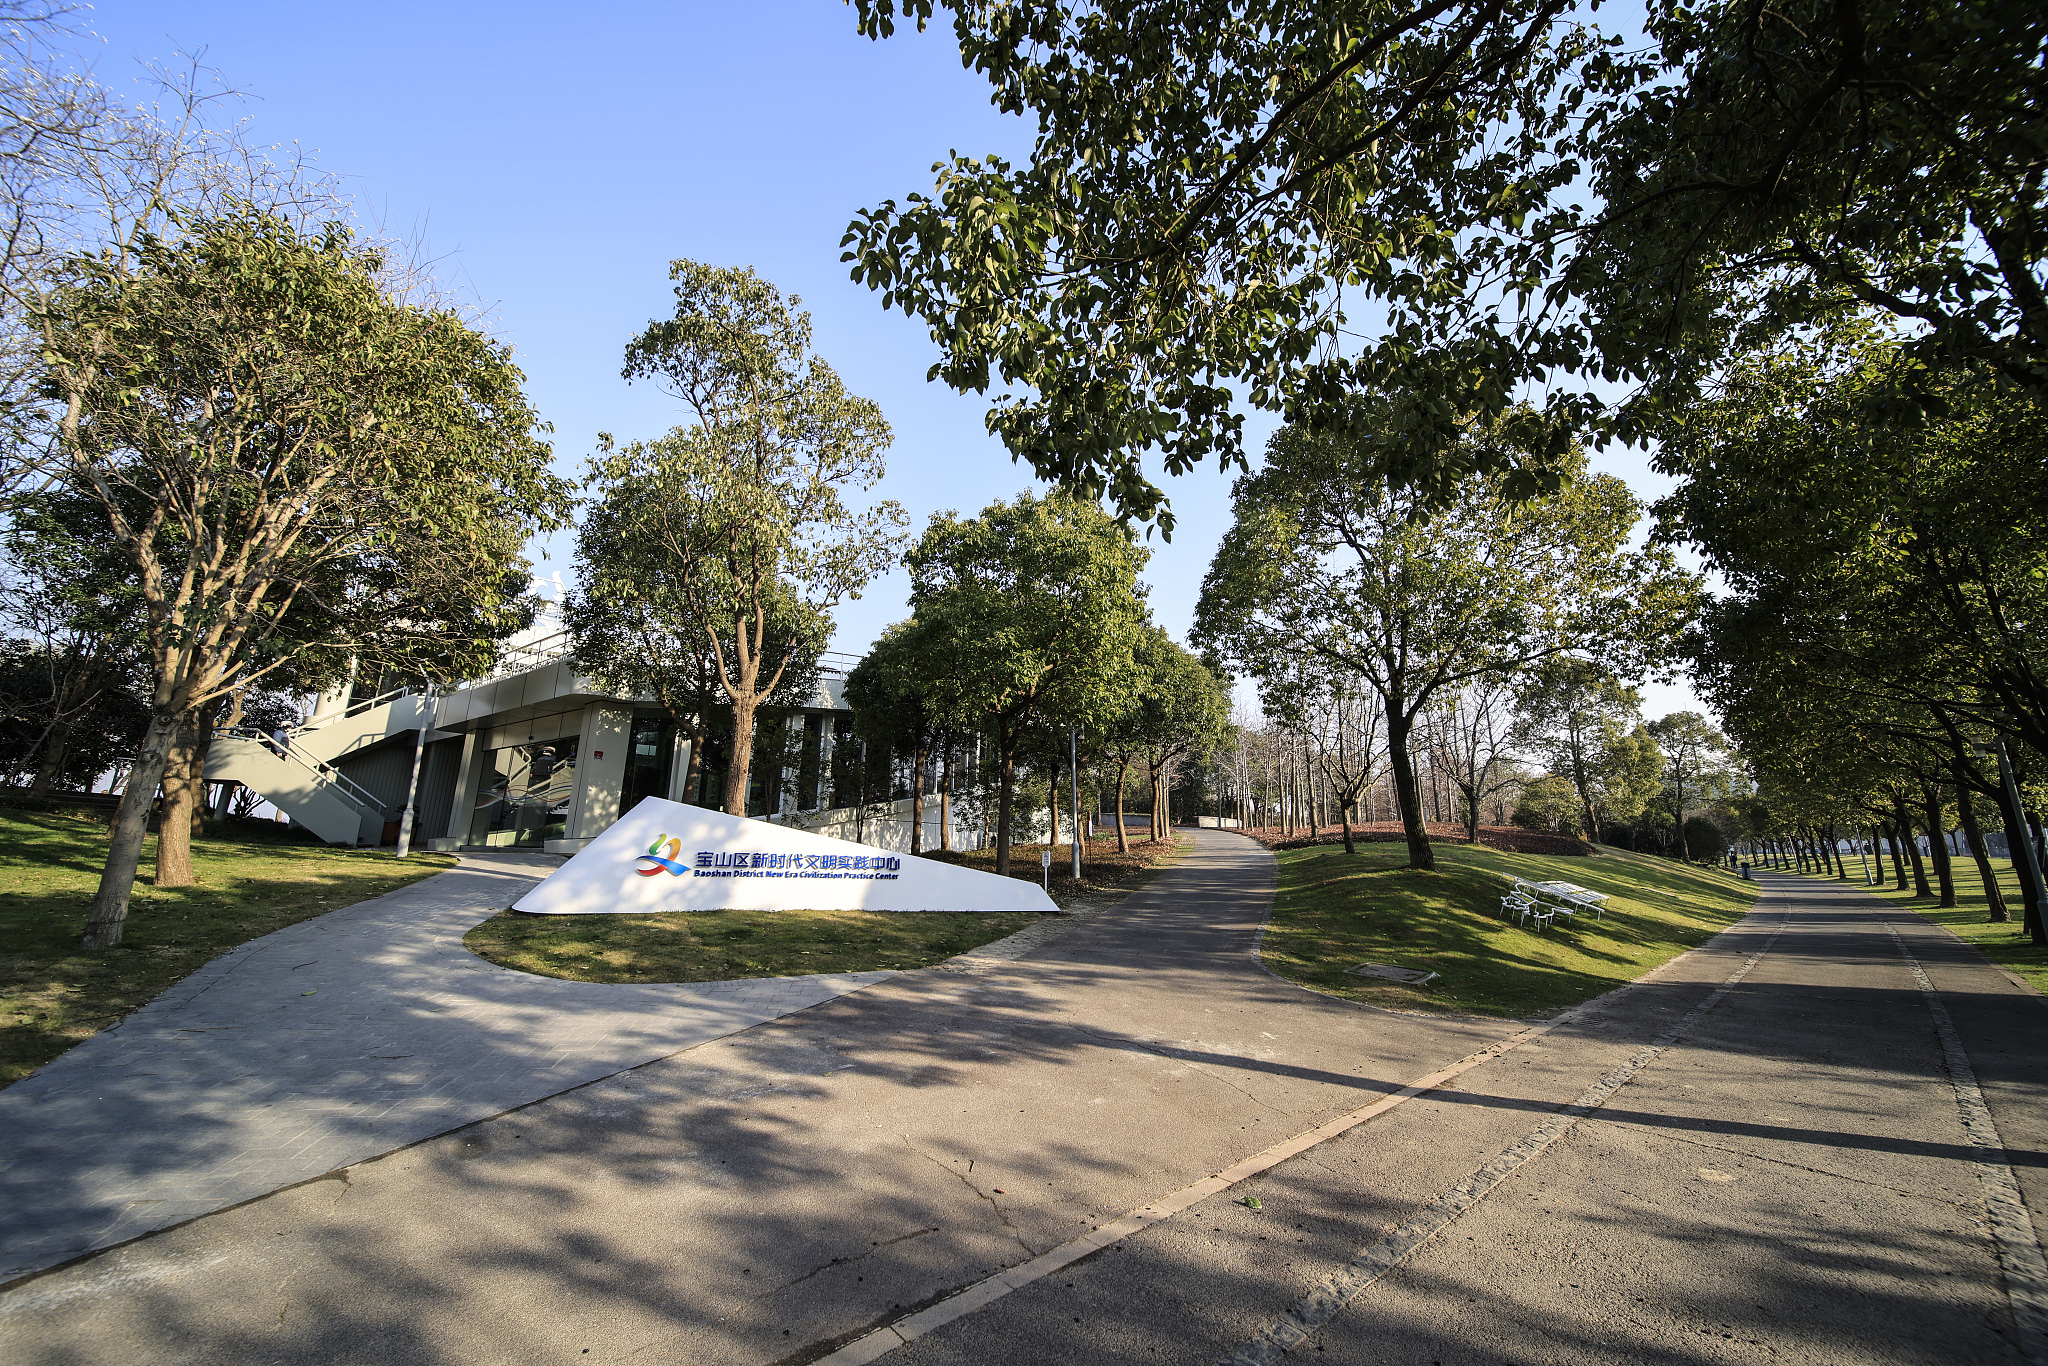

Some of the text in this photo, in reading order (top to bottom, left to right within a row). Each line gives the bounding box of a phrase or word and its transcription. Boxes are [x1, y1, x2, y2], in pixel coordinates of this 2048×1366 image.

[695, 851, 901, 871] 宝山区新时代文明实践中心
[694, 869, 732, 878] Baoshan
[733, 869, 764, 878] District
[766, 870, 784, 878] New
[799, 871, 843, 879] Civilization
[843, 872, 874, 880] Practice
[875, 872, 900, 880] Center
